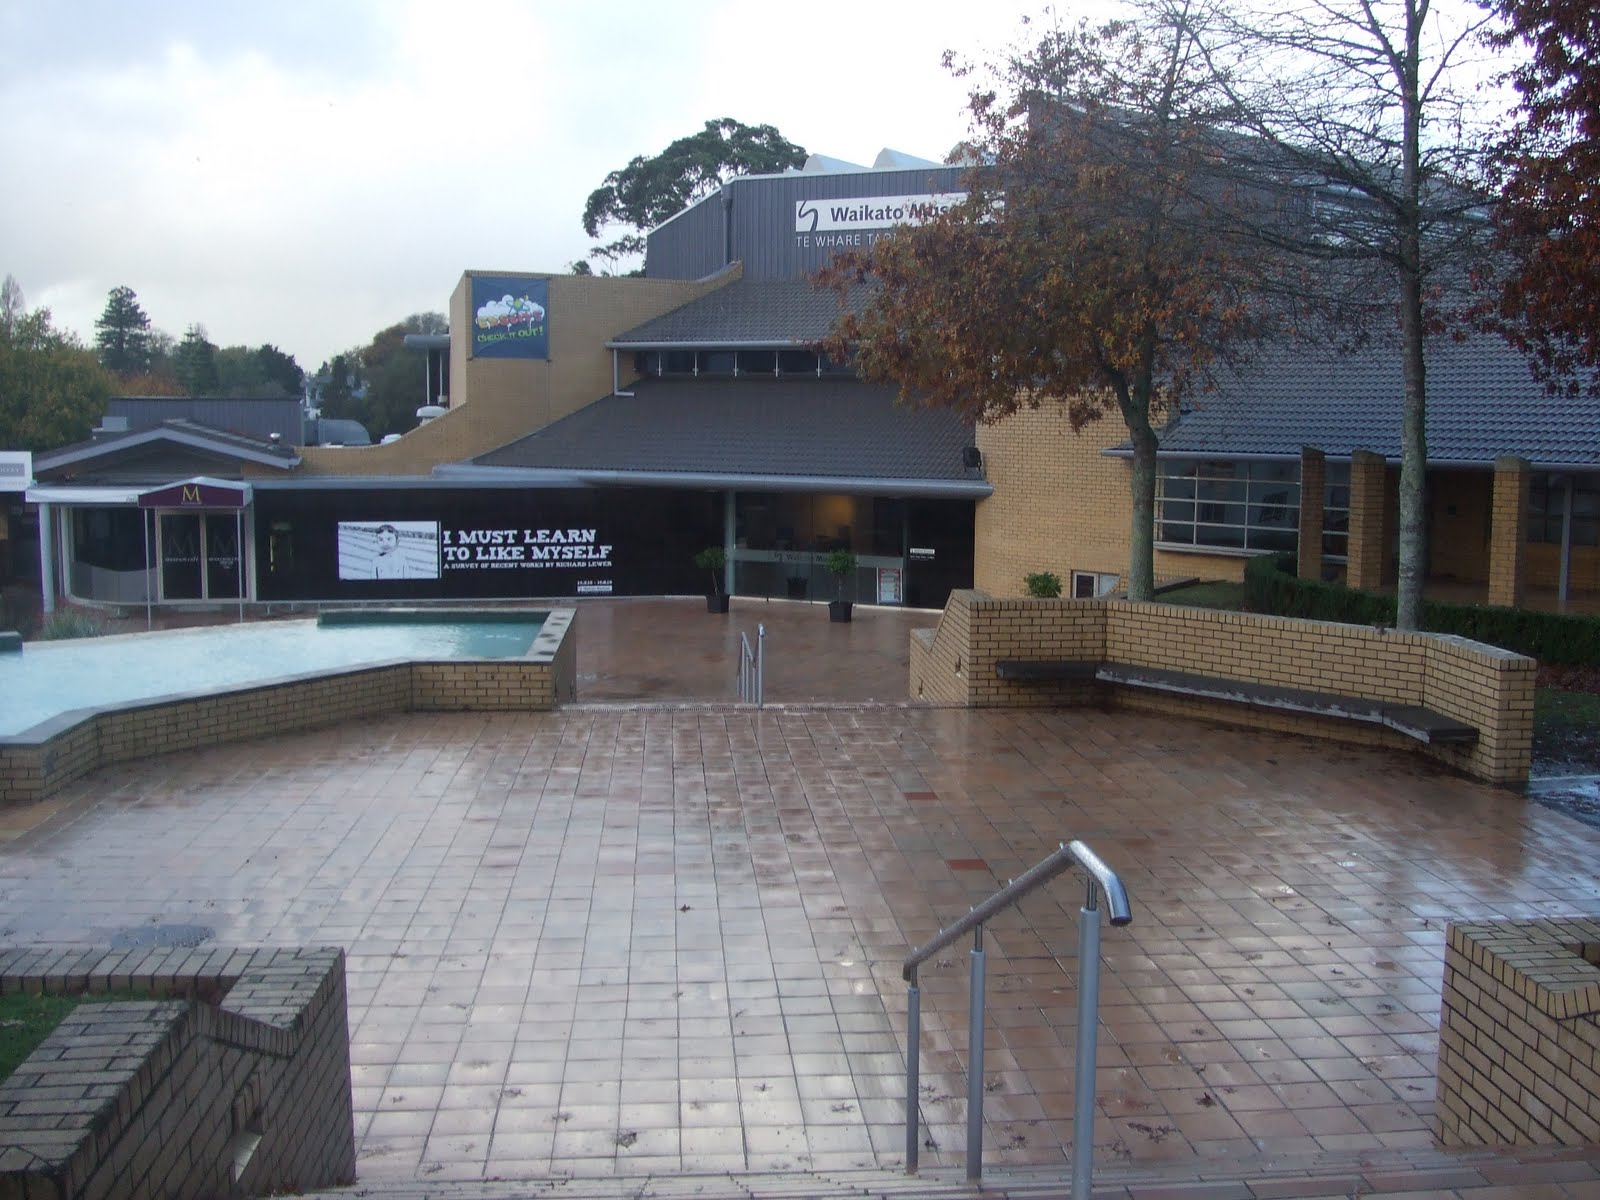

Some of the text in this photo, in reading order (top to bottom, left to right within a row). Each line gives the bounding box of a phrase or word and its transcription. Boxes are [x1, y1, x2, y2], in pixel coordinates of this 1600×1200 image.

[830, 205, 904, 222] Waikato
[796, 236, 810, 248] TE
[815, 233, 861, 247] WHARE
[183, 486, 200, 502] M
[443, 529, 597, 544] I MUST LEARN
[443, 545, 613, 561] TO LIKE MYSELF
[490, 561, 518, 569] RECENT
[587, 560, 612, 568] LEWER
